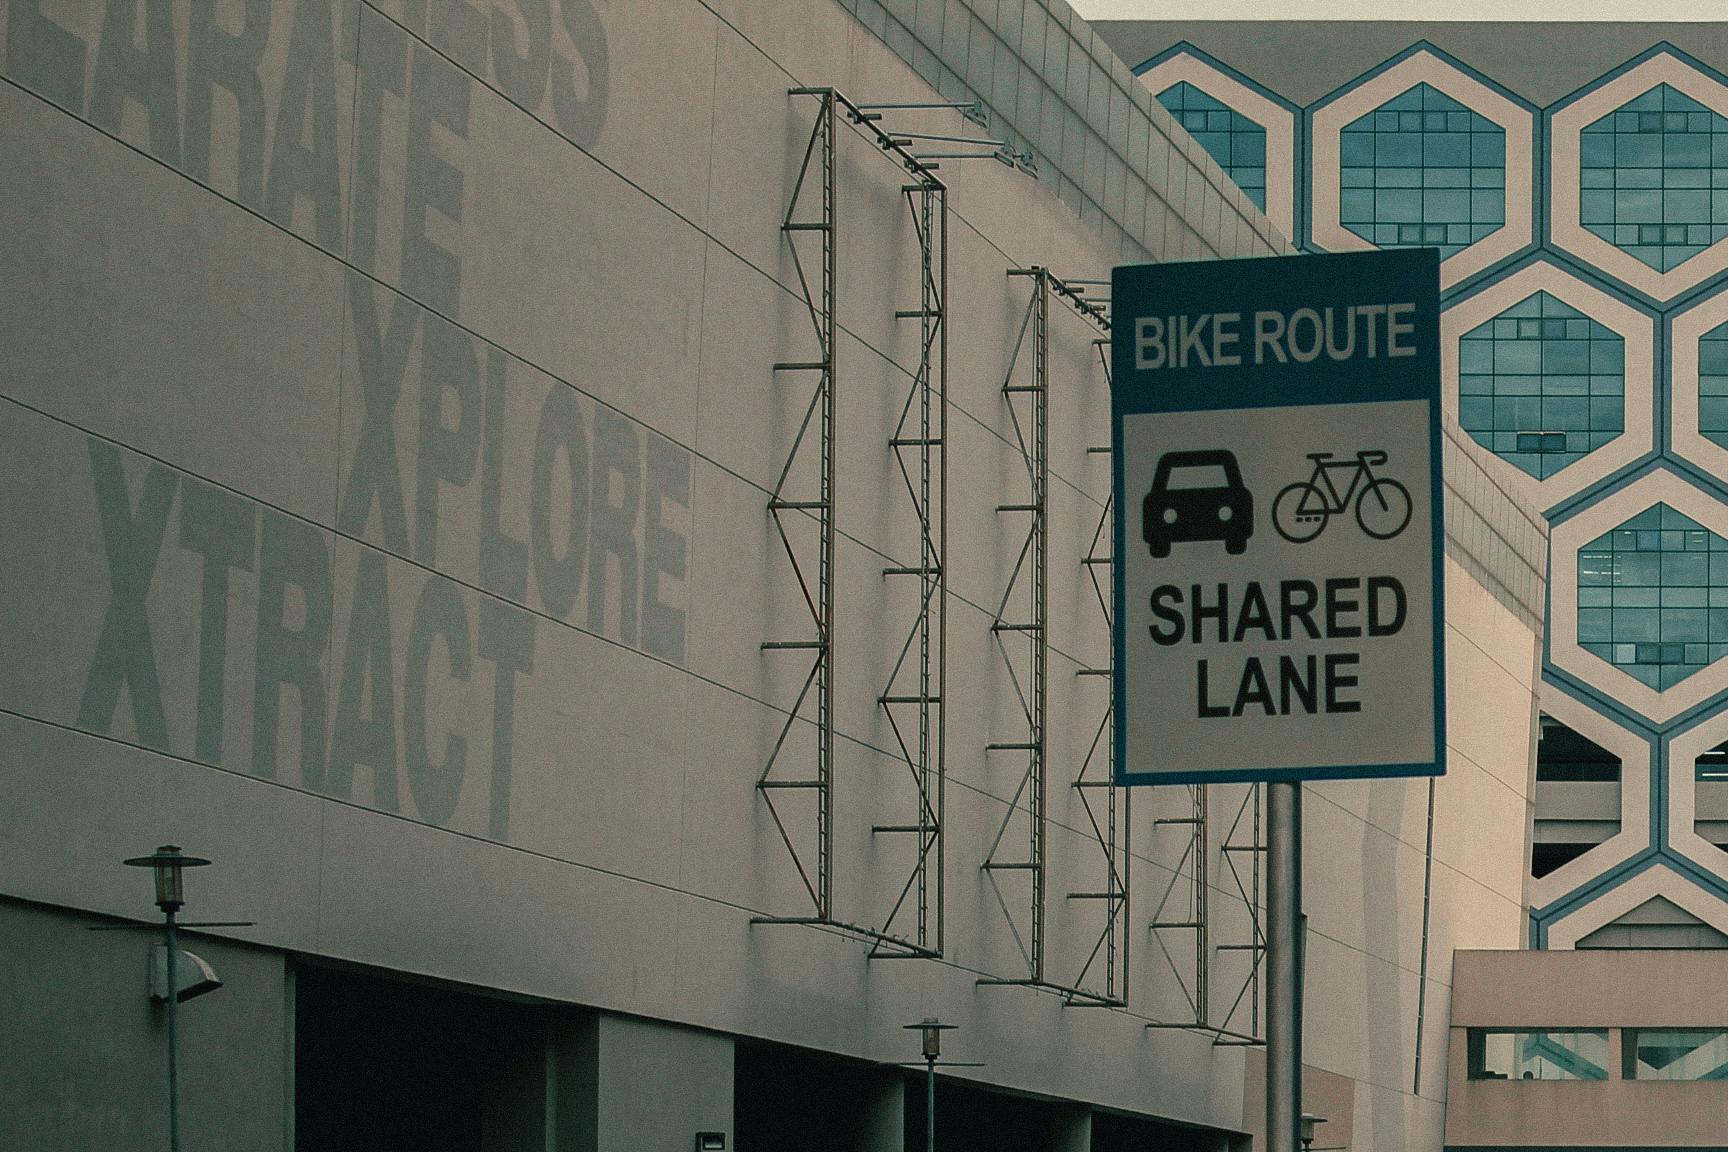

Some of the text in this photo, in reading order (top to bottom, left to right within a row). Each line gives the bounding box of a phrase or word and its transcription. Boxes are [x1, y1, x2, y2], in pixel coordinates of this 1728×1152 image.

[1134, 302, 1417, 371] BIKE ROUTE
[335, 262, 692, 667] XPLORE
[75, 430, 536, 840] XTRACT
[1148, 575, 1408, 646] SHARED
[1197, 652, 1362, 718] LANE
